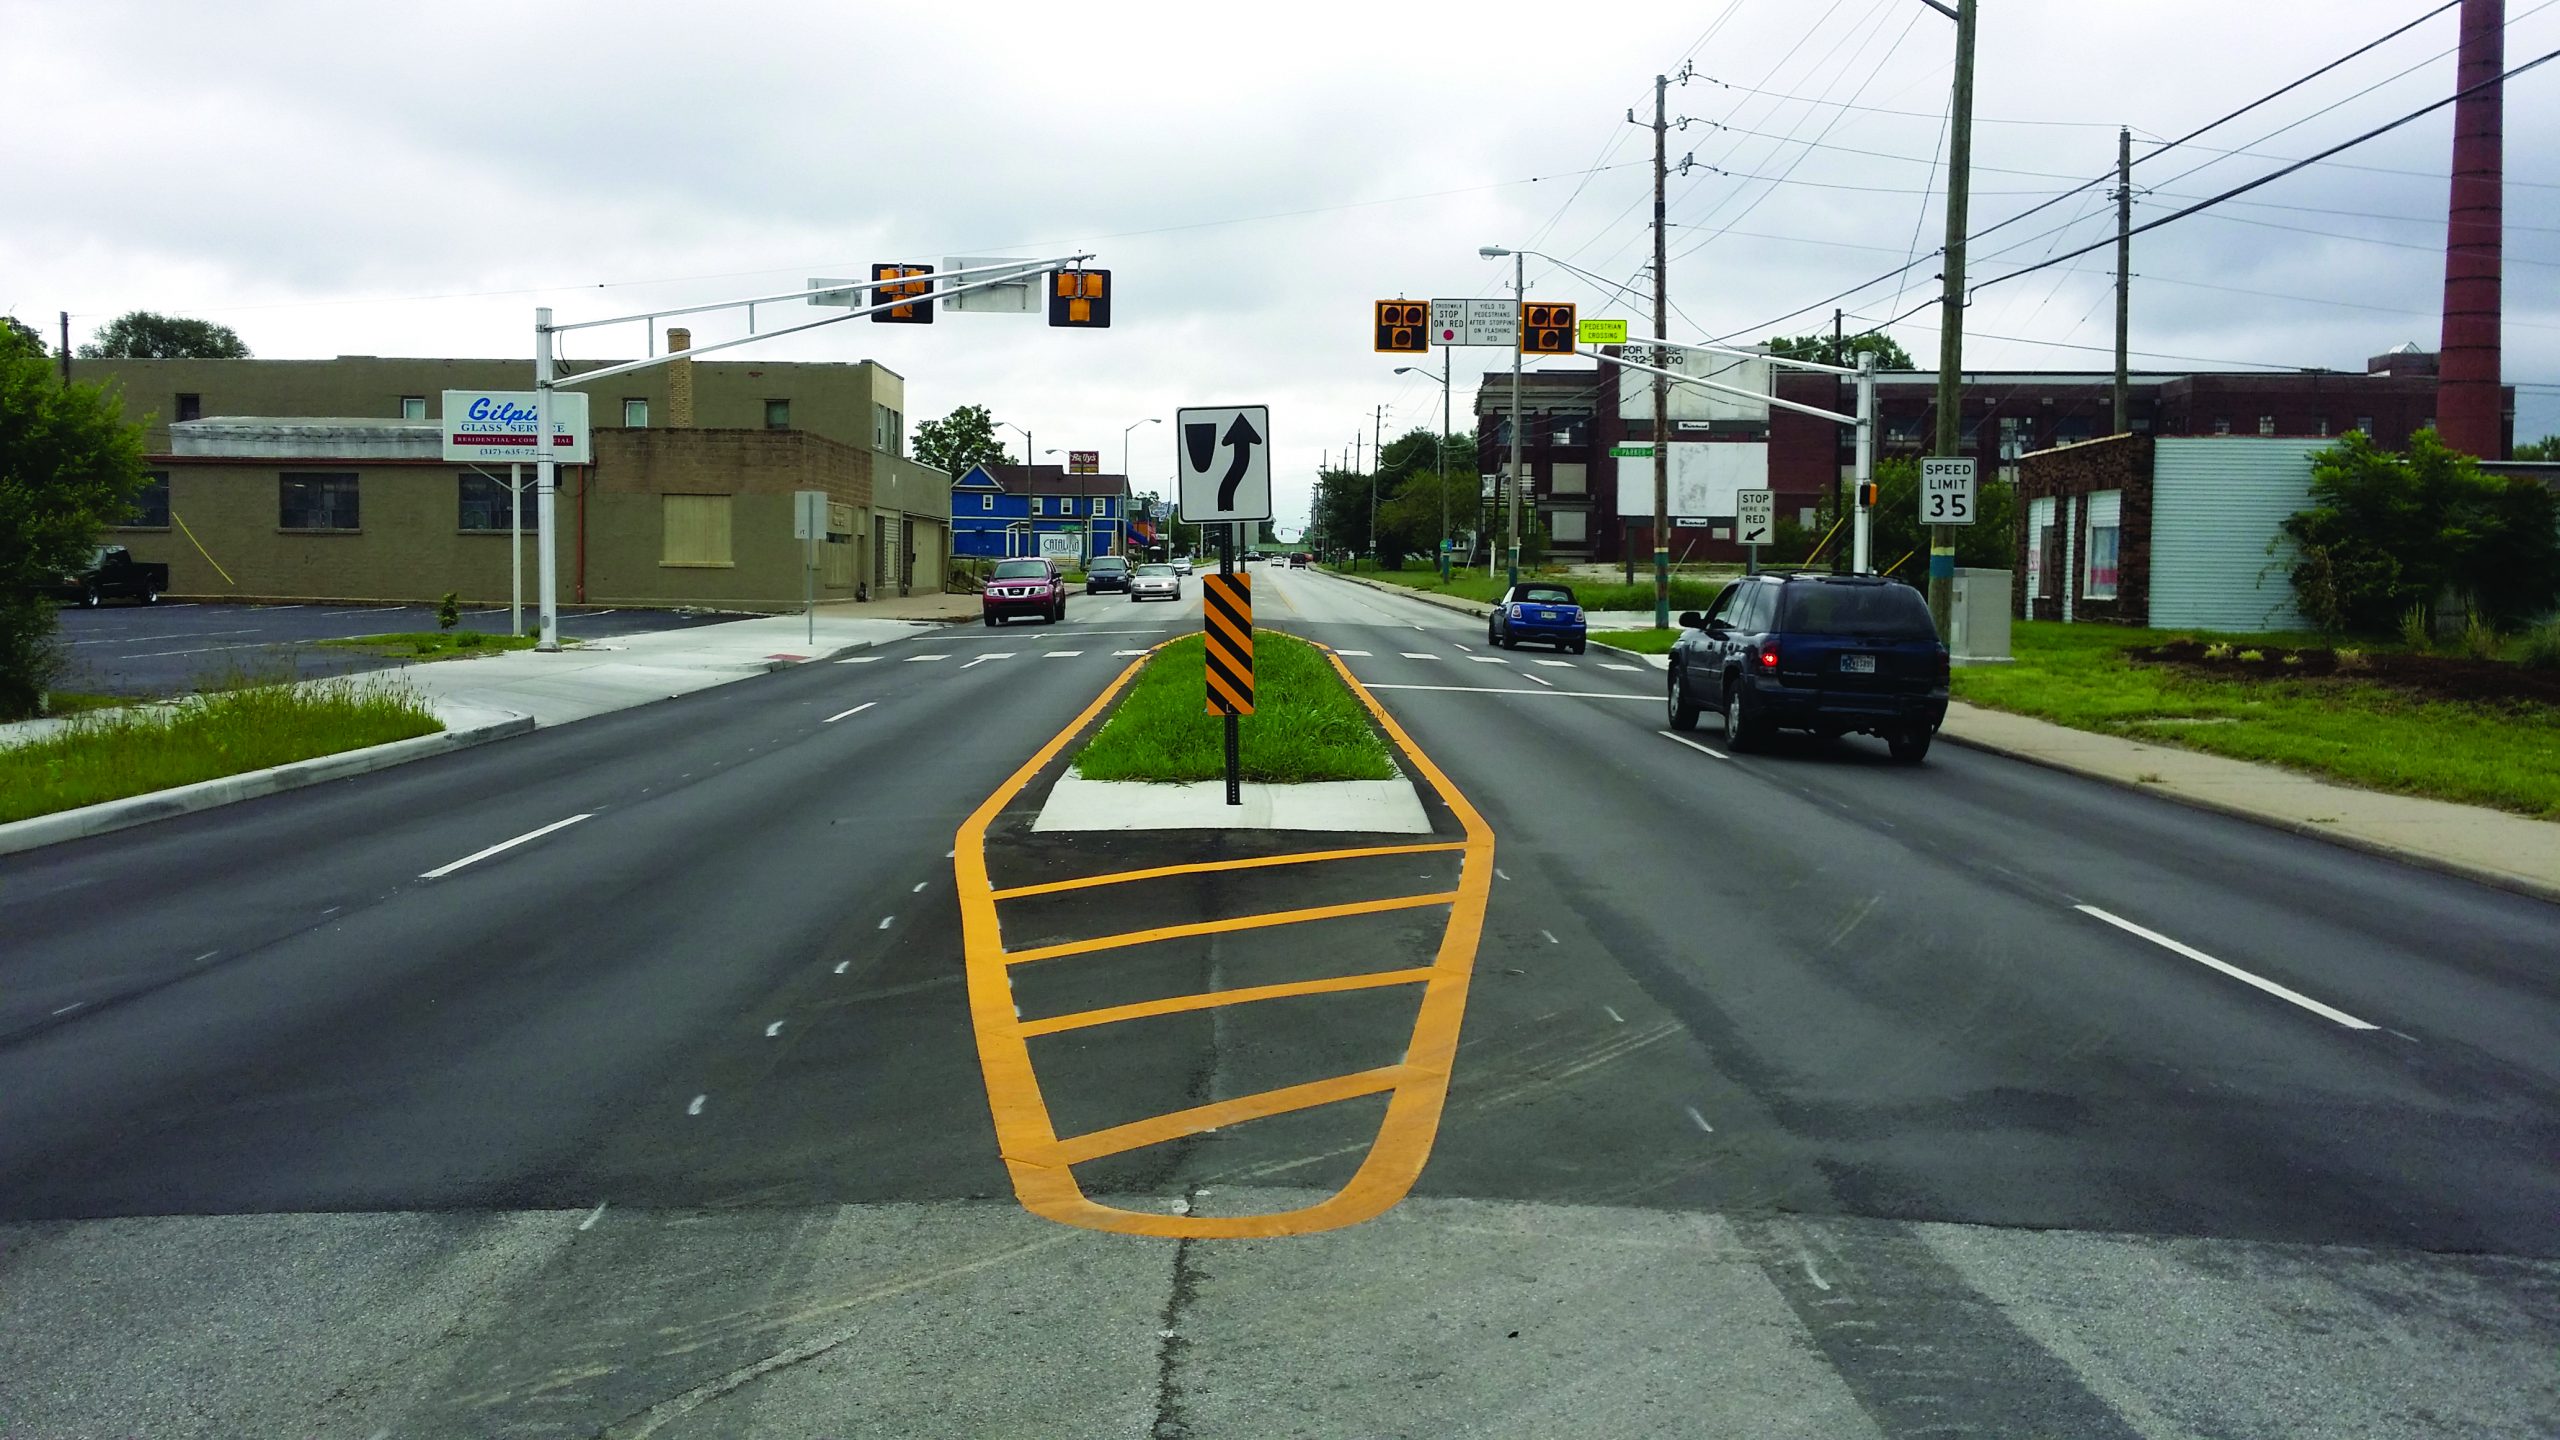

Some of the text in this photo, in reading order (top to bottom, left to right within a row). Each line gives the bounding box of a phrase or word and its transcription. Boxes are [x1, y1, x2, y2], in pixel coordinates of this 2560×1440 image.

[1439, 310, 1459, 318] STOP
[1433, 319, 1464, 328] ON RED
[1622, 345, 1681, 355] FOR LSE
[468, 397, 538, 426] Gilpi
[461, 423, 503, 432] GLASS
[1925, 464, 1971, 475] SPEED
[1929, 479, 1967, 490] LIMIT
[1742, 494, 1770, 503] STOP
[1930, 494, 1967, 517] 35
[1745, 514, 1766, 524] RED
